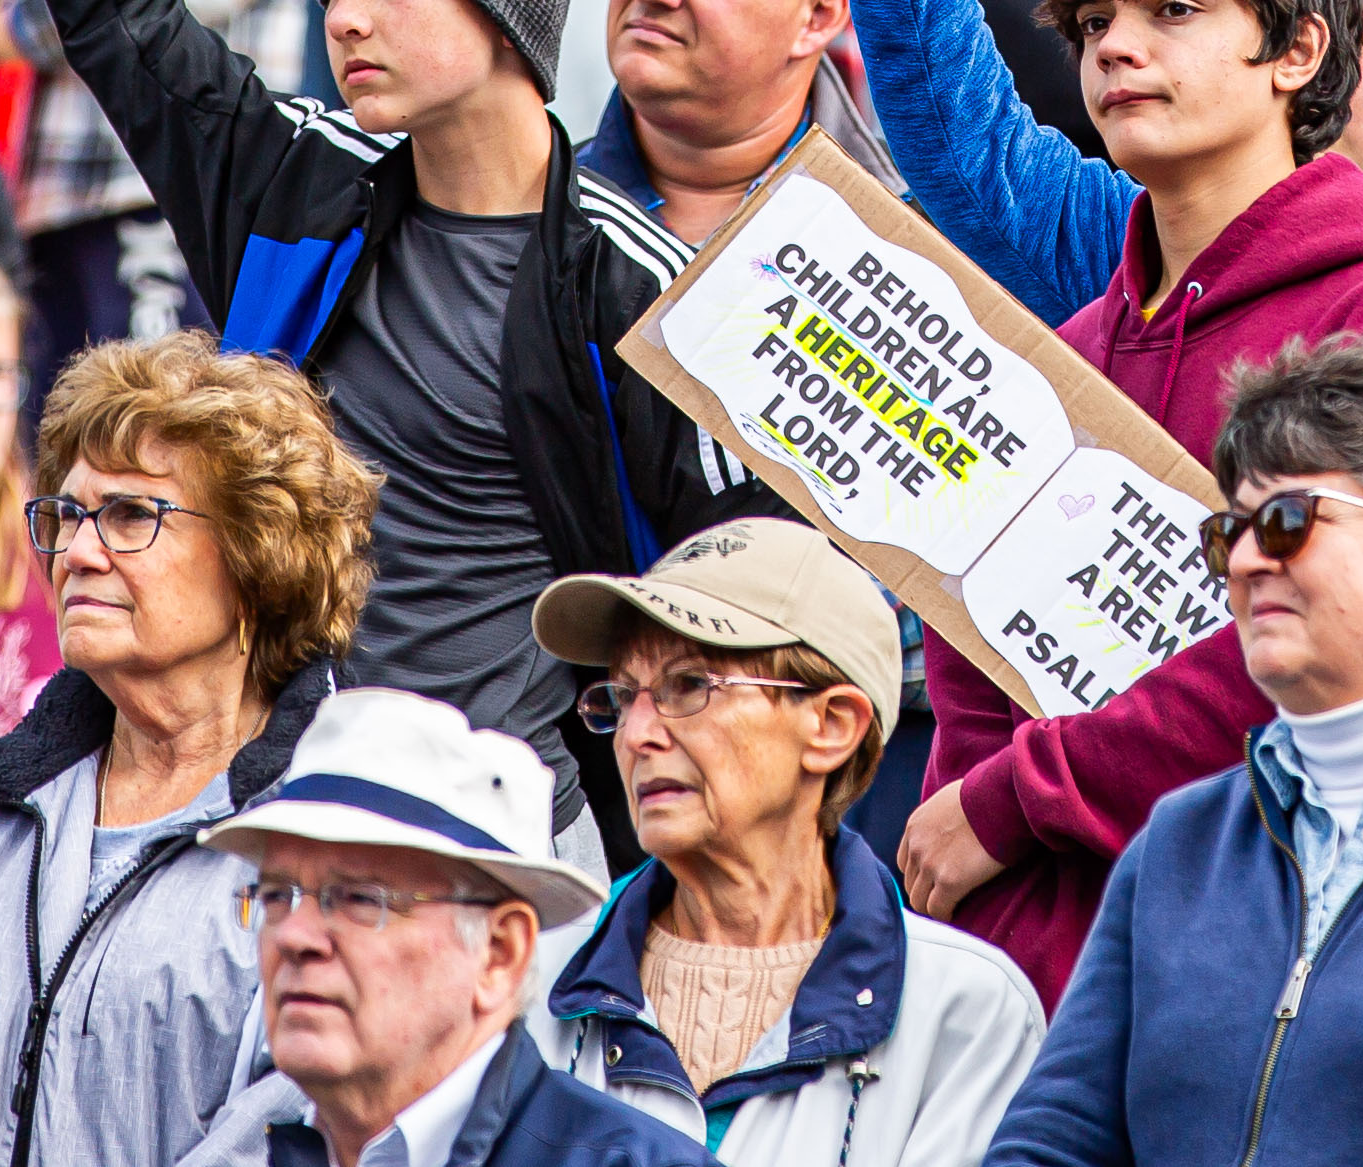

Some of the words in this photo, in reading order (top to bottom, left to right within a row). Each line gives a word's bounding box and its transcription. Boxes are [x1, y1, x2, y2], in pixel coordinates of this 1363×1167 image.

[764, 294, 799, 329] A
[796, 315, 978, 480] HERITAGE
[775, 243, 952, 402] CHILDREN
[942, 395, 1027, 468] ARE
[847, 251, 993, 397] BEHOLD,
[752, 332, 864, 434] FROM
[860, 421, 936, 498] THE
[760, 393, 861, 500] LORD,
[1102, 528, 1179, 606] THE
[1111, 481, 1188, 559] THE
[1066, 563, 1101, 599] A
[1098, 585, 1180, 665] REW
